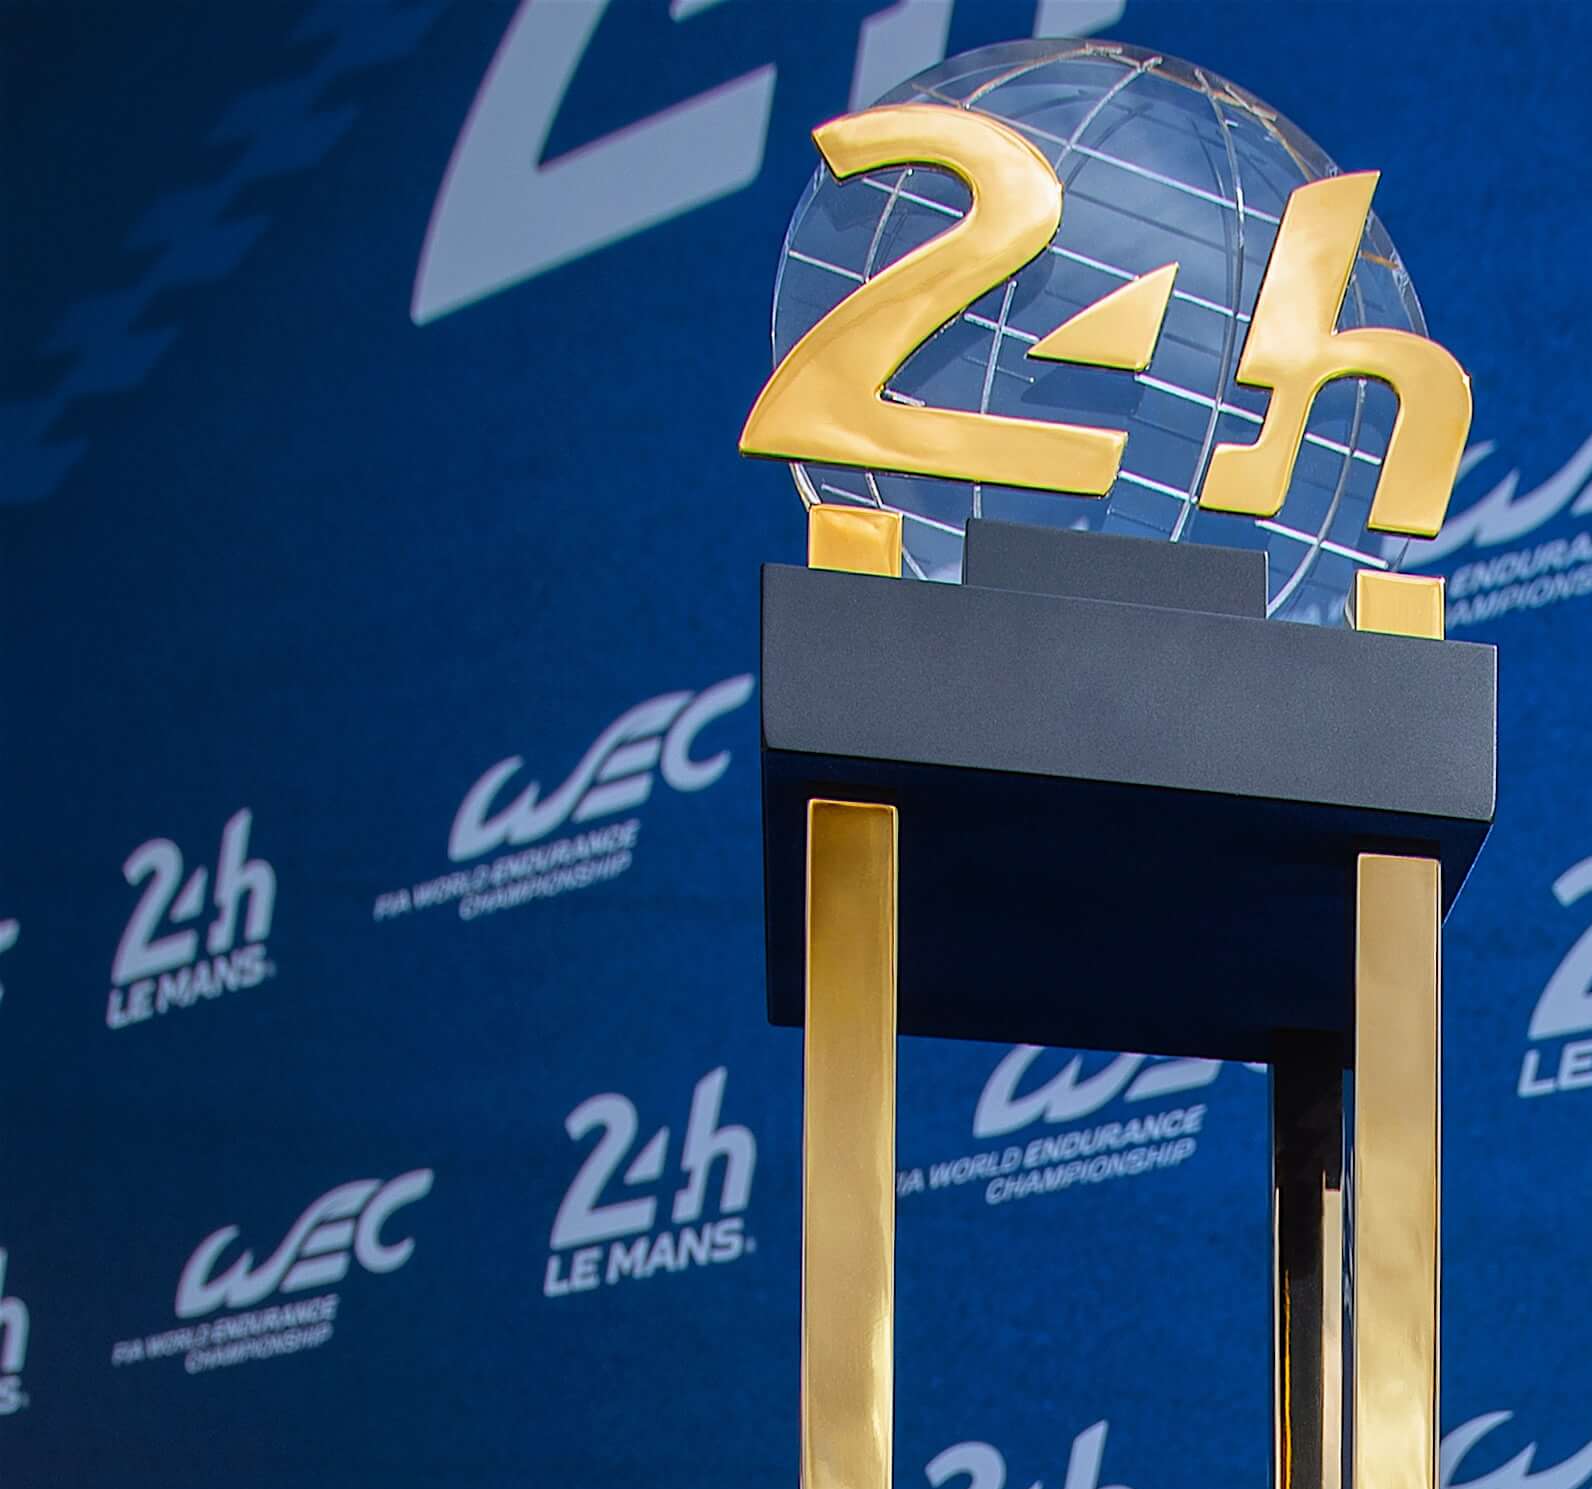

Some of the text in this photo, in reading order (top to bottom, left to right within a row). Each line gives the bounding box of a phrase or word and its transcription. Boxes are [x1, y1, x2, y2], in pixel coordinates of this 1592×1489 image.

[738, 103, 1473, 538] 24h
[448, 674, 754, 862] WEC
[110, 806, 277, 987] 24h
[550, 1065, 757, 1251] 24h
[897, 1103, 1207, 1198] IA WORLD ENDURANCE
[985, 1137, 1198, 1206] CHAMPIONSHIP
[175, 1168, 434, 1319] WEC
[543, 1246, 603, 1298] LE
